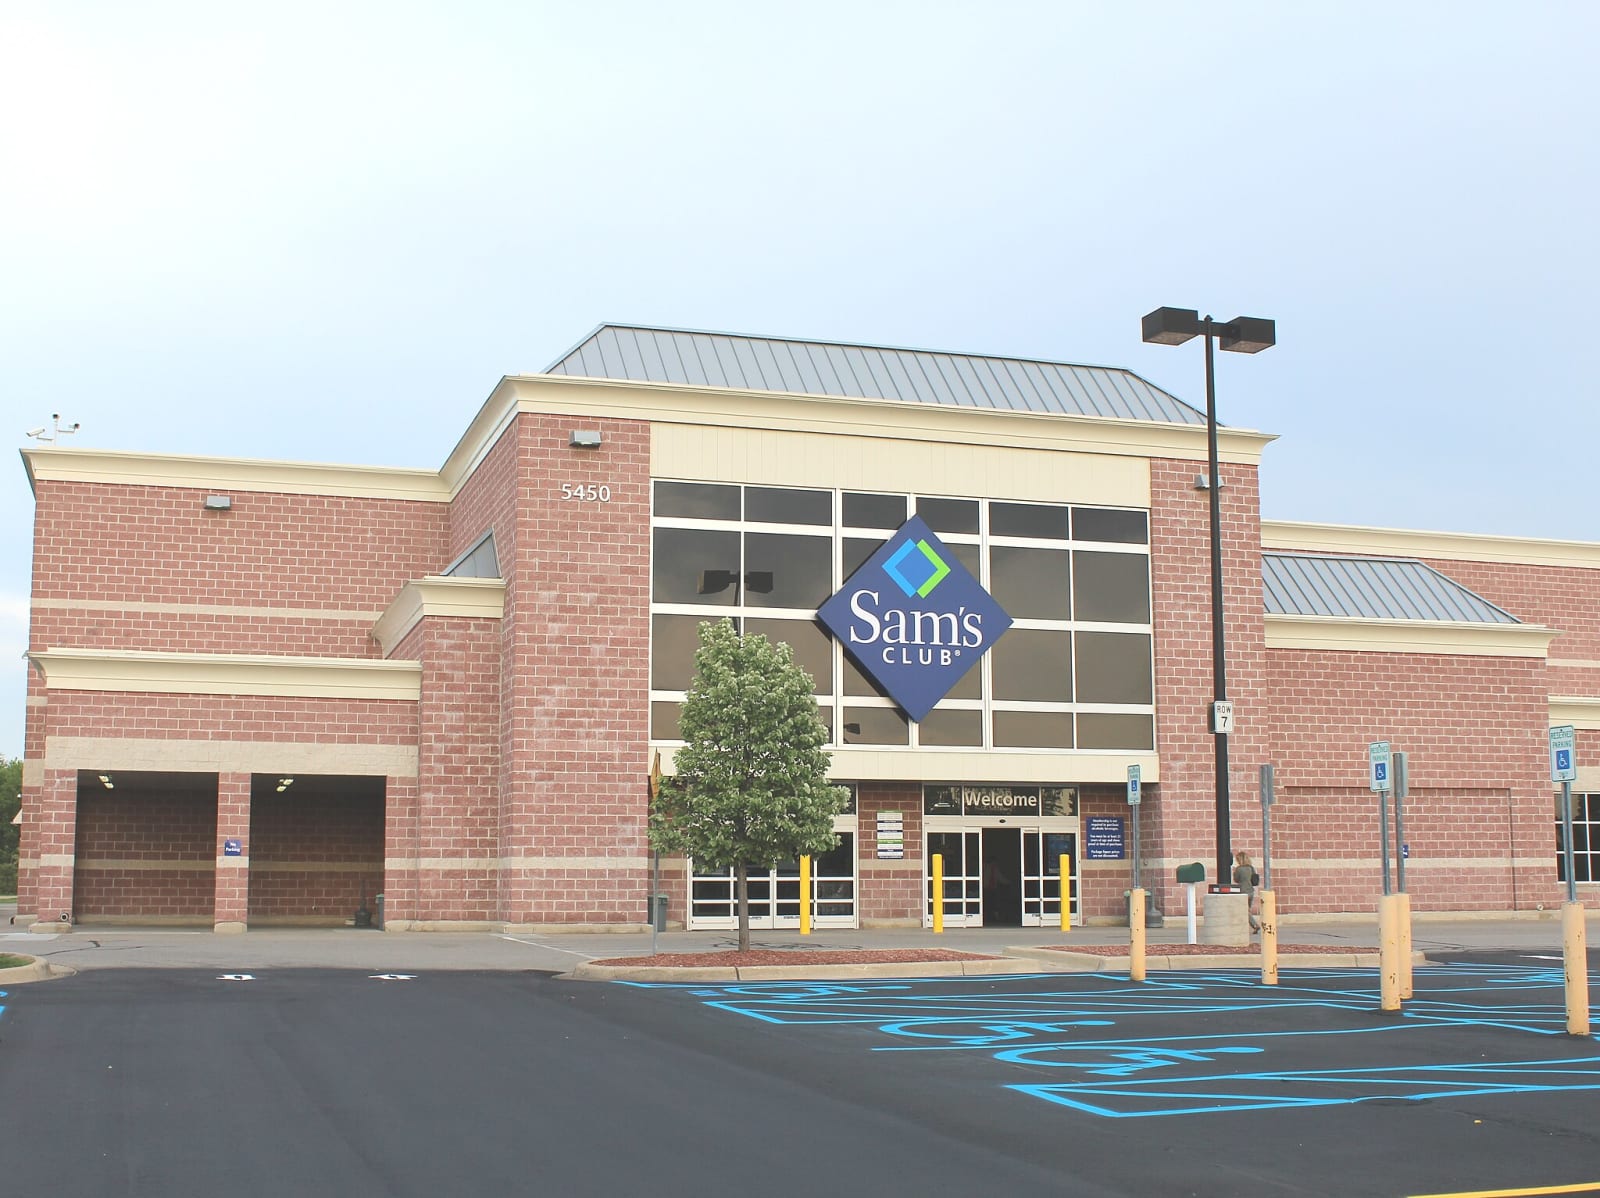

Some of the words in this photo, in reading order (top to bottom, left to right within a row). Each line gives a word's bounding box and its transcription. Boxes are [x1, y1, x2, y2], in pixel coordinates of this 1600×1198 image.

[561, 483, 611, 502] 5450
[850, 589, 983, 648] Sam's
[1216, 705, 1231, 714] ROW
[1221, 716, 1228, 728] 7
[964, 791, 1038, 807] Welcome
